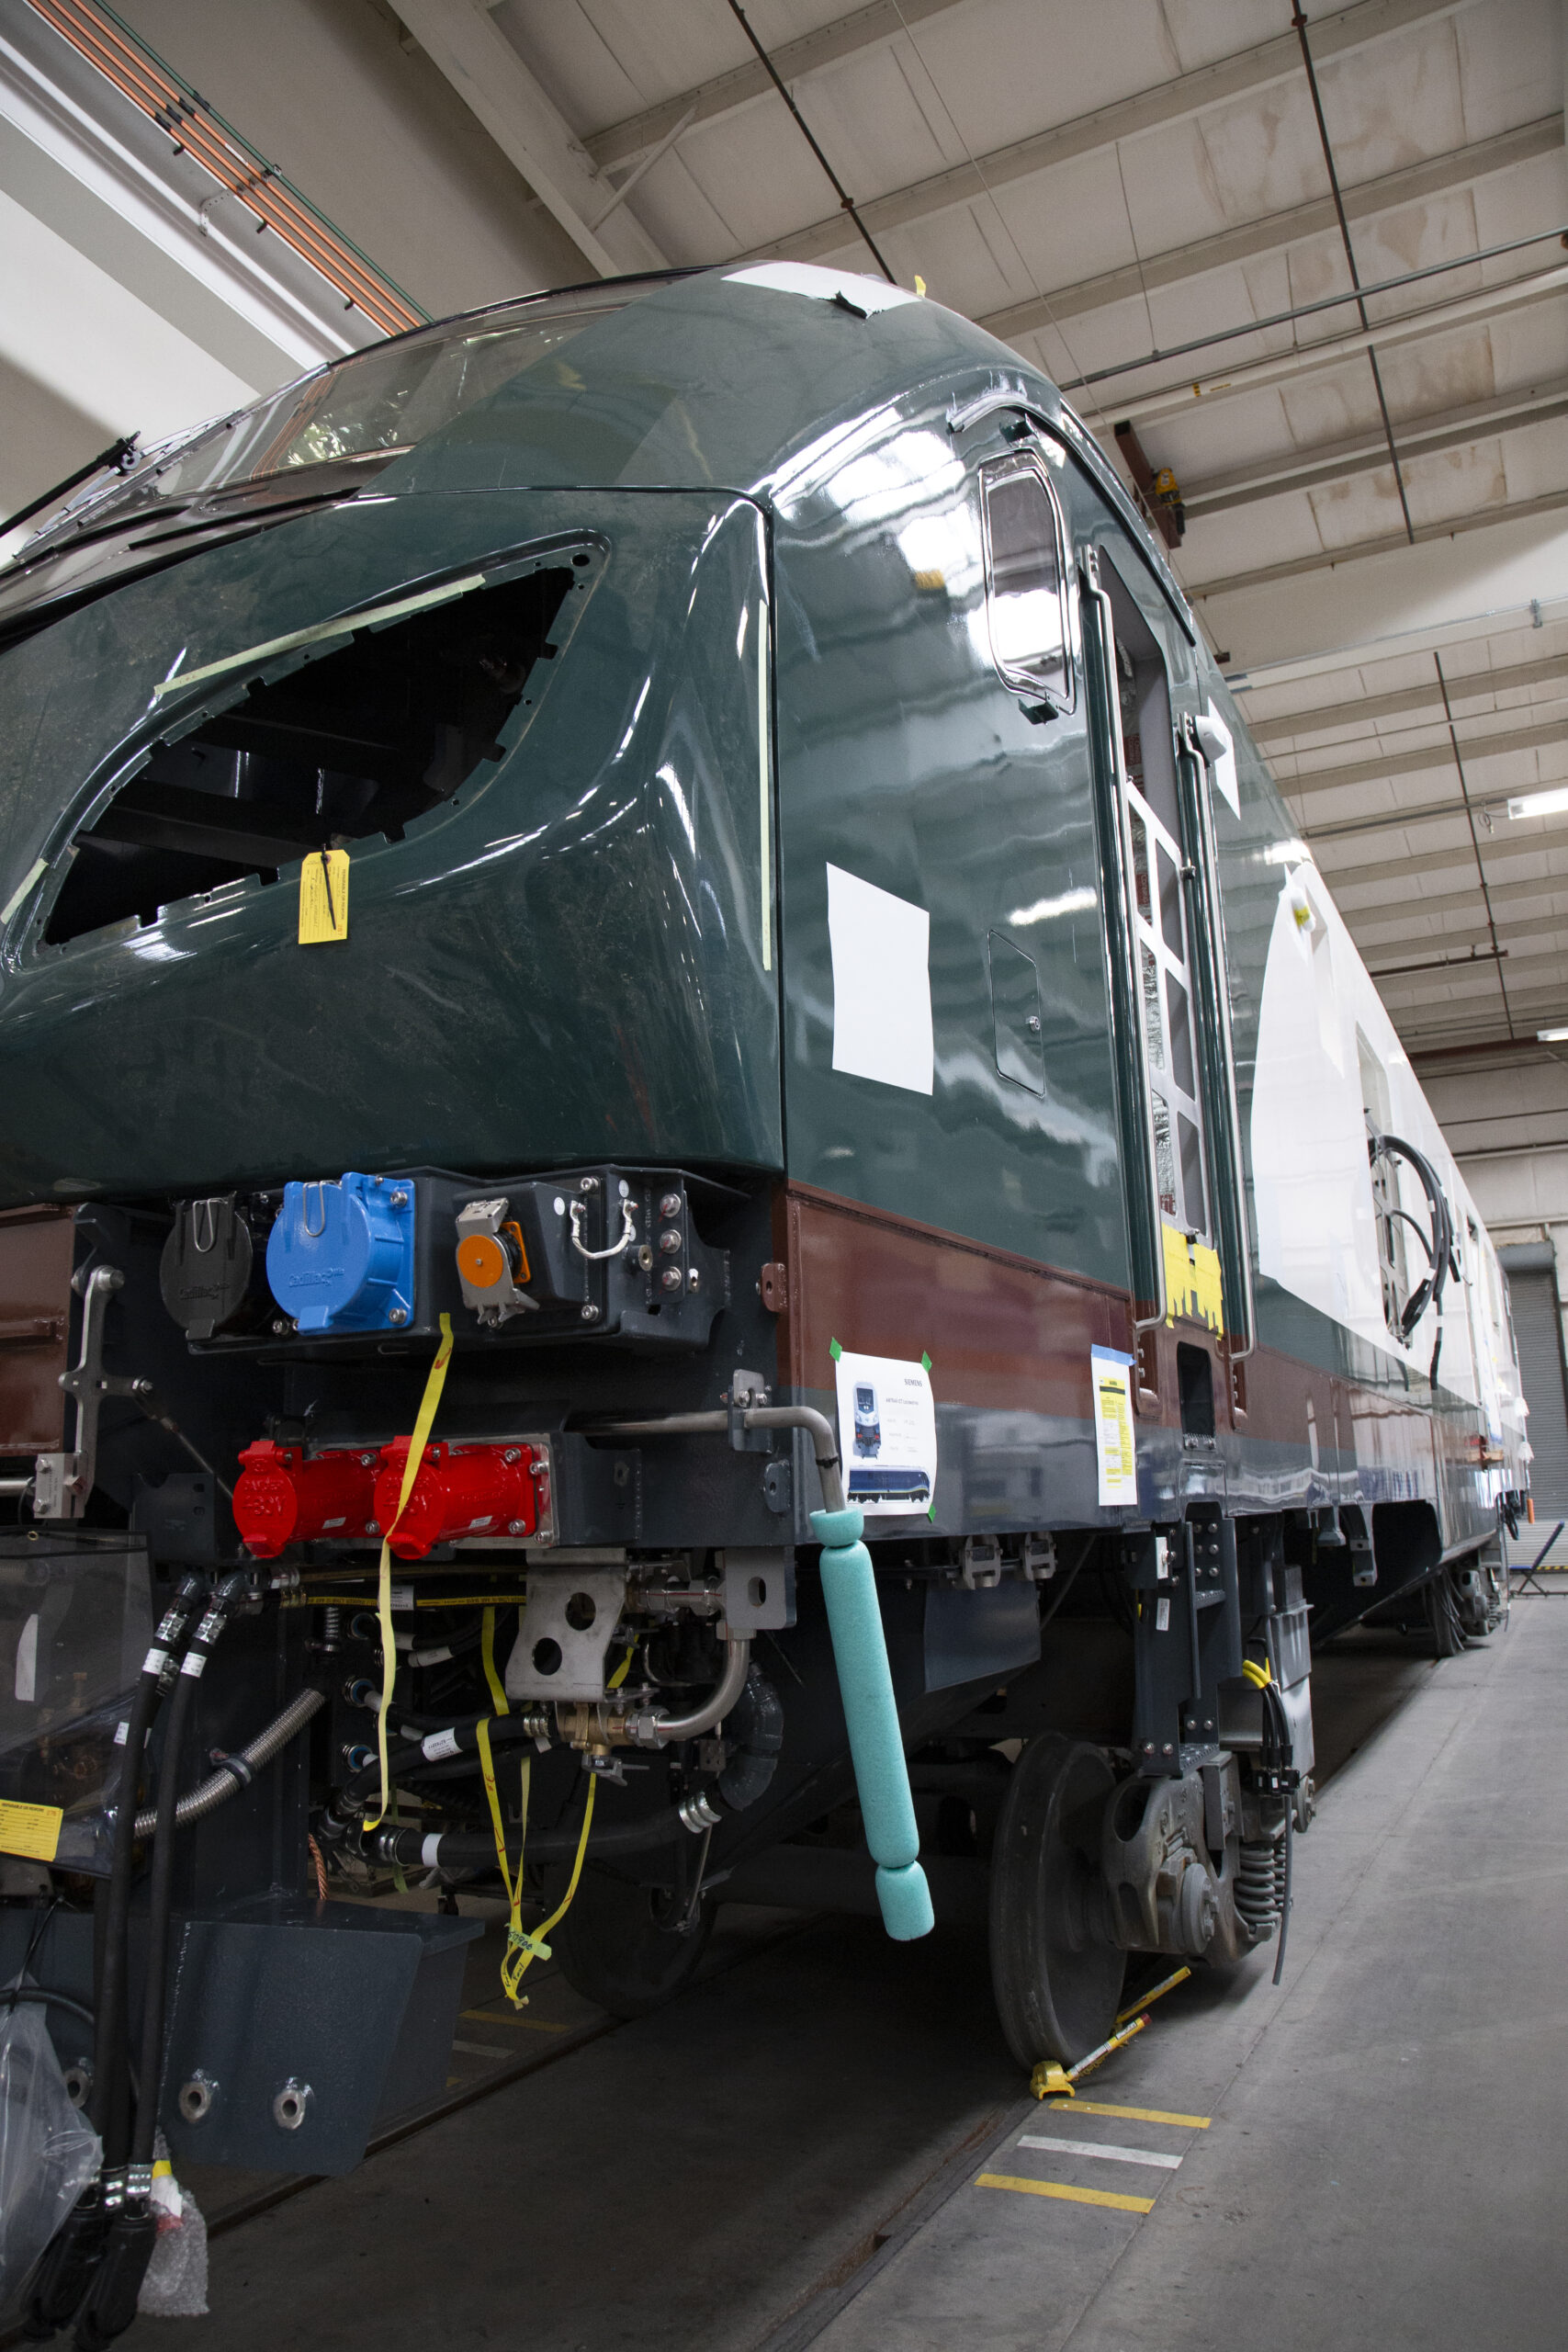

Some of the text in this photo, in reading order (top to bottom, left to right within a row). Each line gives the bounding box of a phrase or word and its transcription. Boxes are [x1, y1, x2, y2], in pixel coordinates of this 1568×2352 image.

[904, 1378, 923, 1387] SIEMENS
[243, 1477, 286, 1492] DANGER
[241, 1495, 287, 1516] 480V
